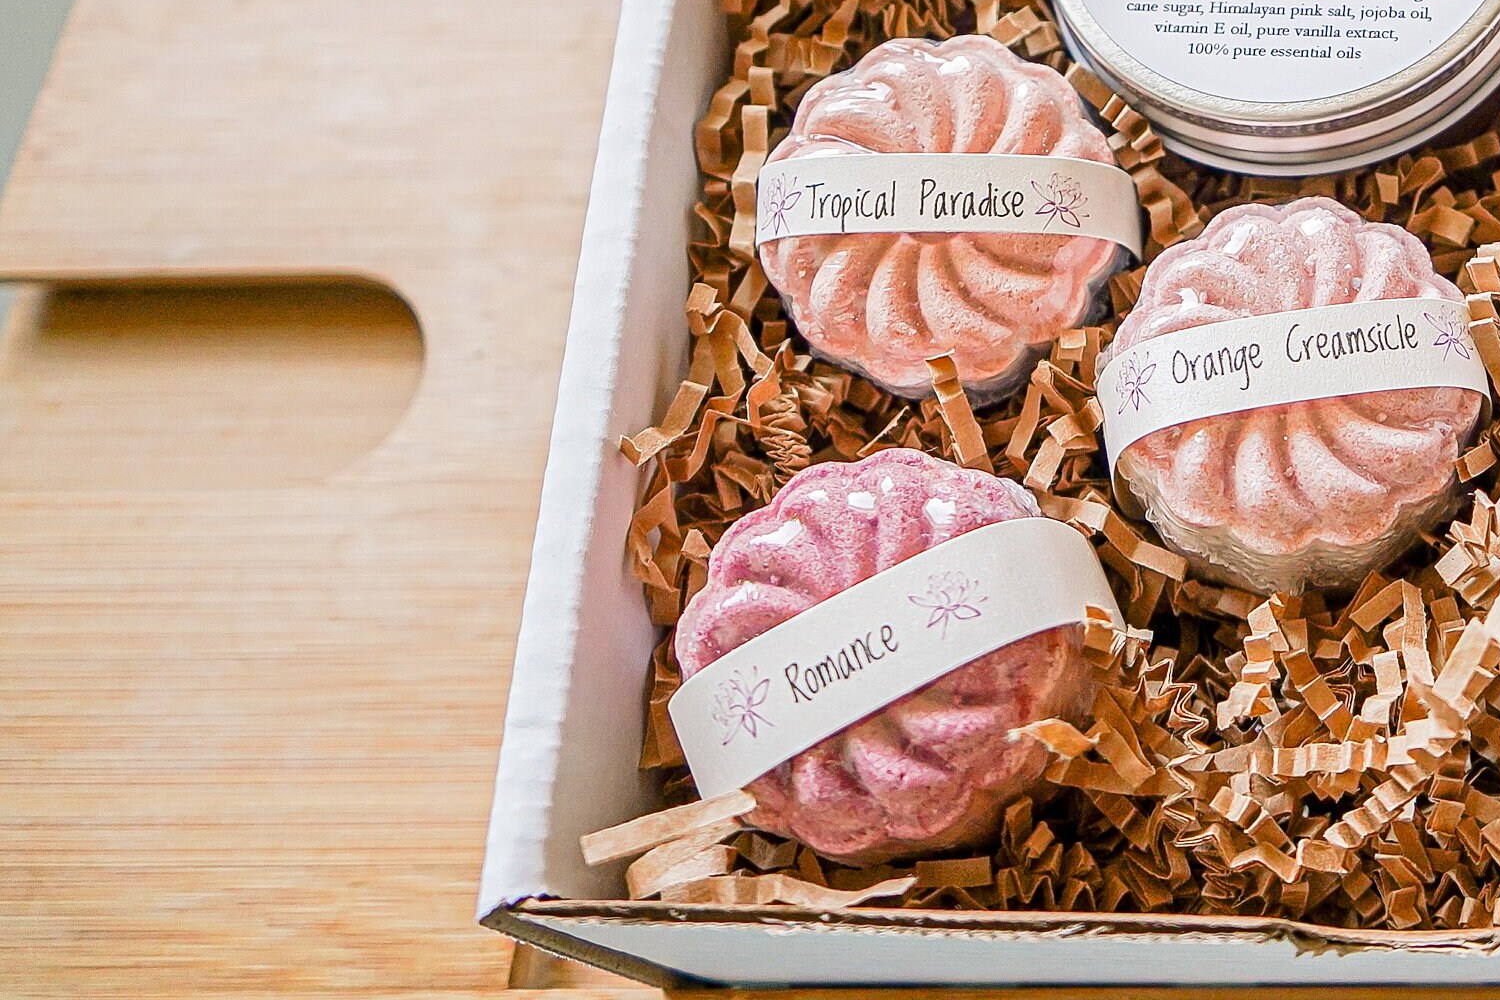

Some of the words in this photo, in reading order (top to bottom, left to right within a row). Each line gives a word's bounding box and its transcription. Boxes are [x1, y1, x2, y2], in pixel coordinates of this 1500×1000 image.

[1126, 2, 1159, 12] cane
[1163, 3, 1204, 17] sugar,
[1209, 1, 1286, 19] Himalayan
[1290, 3, 1322, 20] pink
[1327, 5, 1356, 19] salt,
[1359, 5, 1406, 22] jojoba
[1410, 7, 1433, 22] oil,
[1154, 20, 1208, 34] vitamin
[1213, 22, 1225, 35] E
[1230, 22, 1252, 38] oil,
[1256, 27, 1290, 40] pure
[1294, 25, 1341, 38] vanilla
[1345, 28, 1399, 41] extract,
[1187, 43, 1229, 56] 100%
[1232, 46, 1267, 60] pure
[1270, 45, 1331, 58] essential
[1336, 47, 1362, 59] oils
[804, 181, 897, 231] Tropical
[918, 178, 1026, 220] Paradise
[1171, 341, 1264, 391] Orange
[1286, 315, 1420, 362] Creamsicle
[783, 620, 900, 705] Romance
